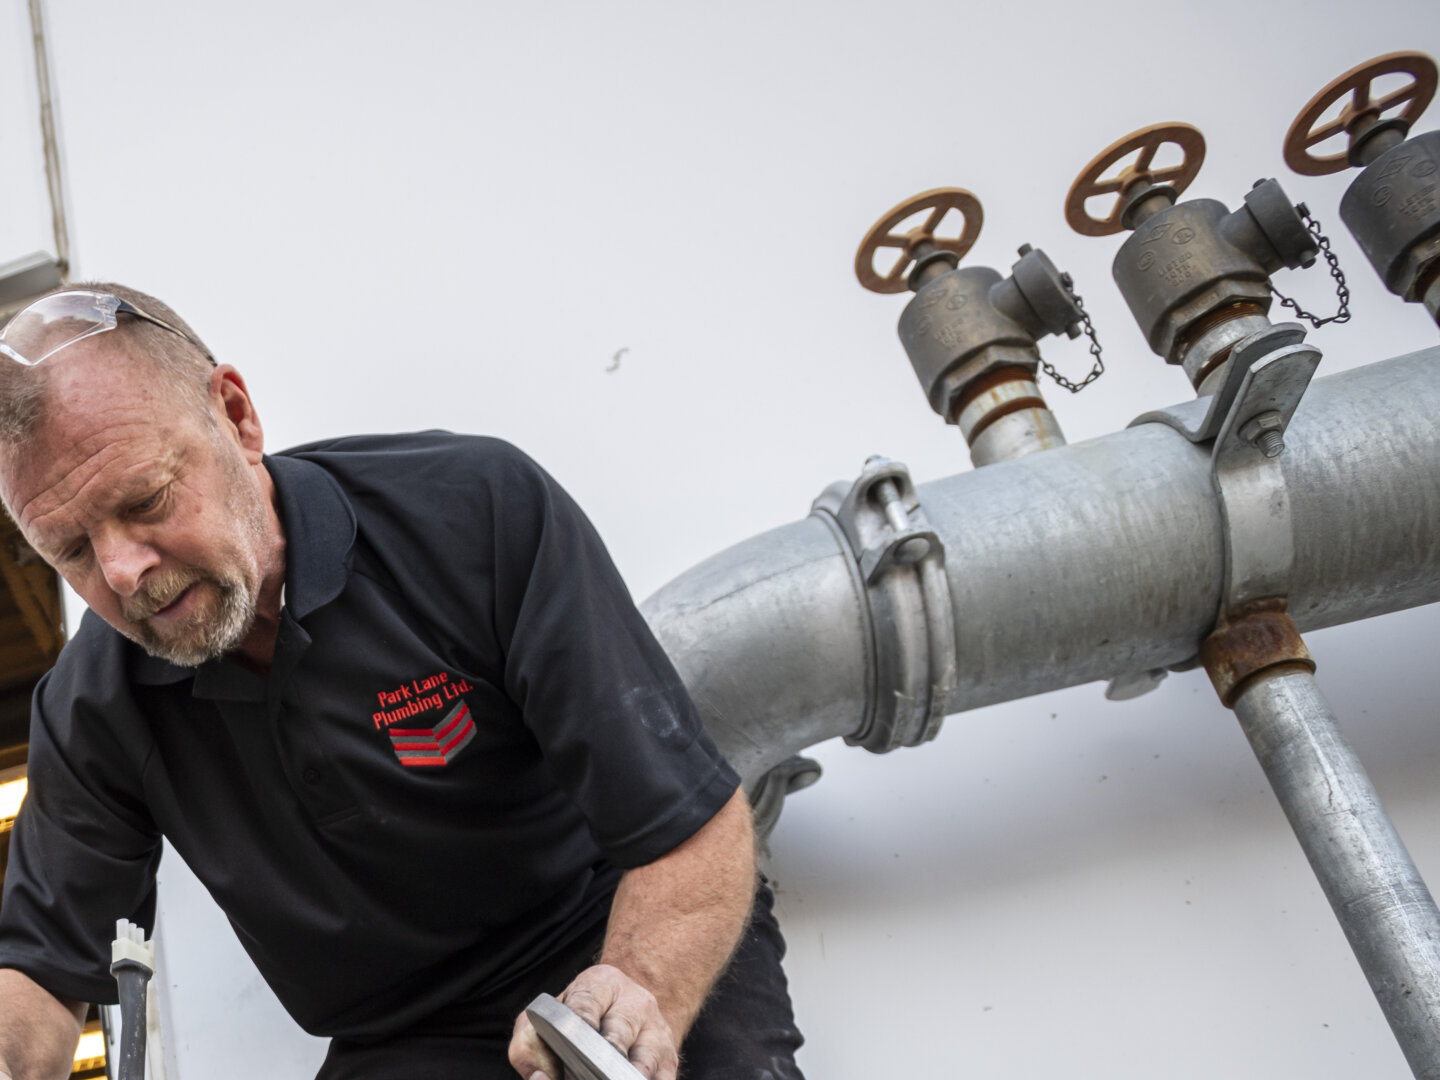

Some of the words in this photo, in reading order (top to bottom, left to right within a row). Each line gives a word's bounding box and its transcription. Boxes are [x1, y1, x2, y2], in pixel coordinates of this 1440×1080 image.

[372, 693, 443, 730] Plumbing
[442, 678, 474, 700] Ltd.
[377, 684, 413, 708] Park
[412, 671, 448, 695] Lane
